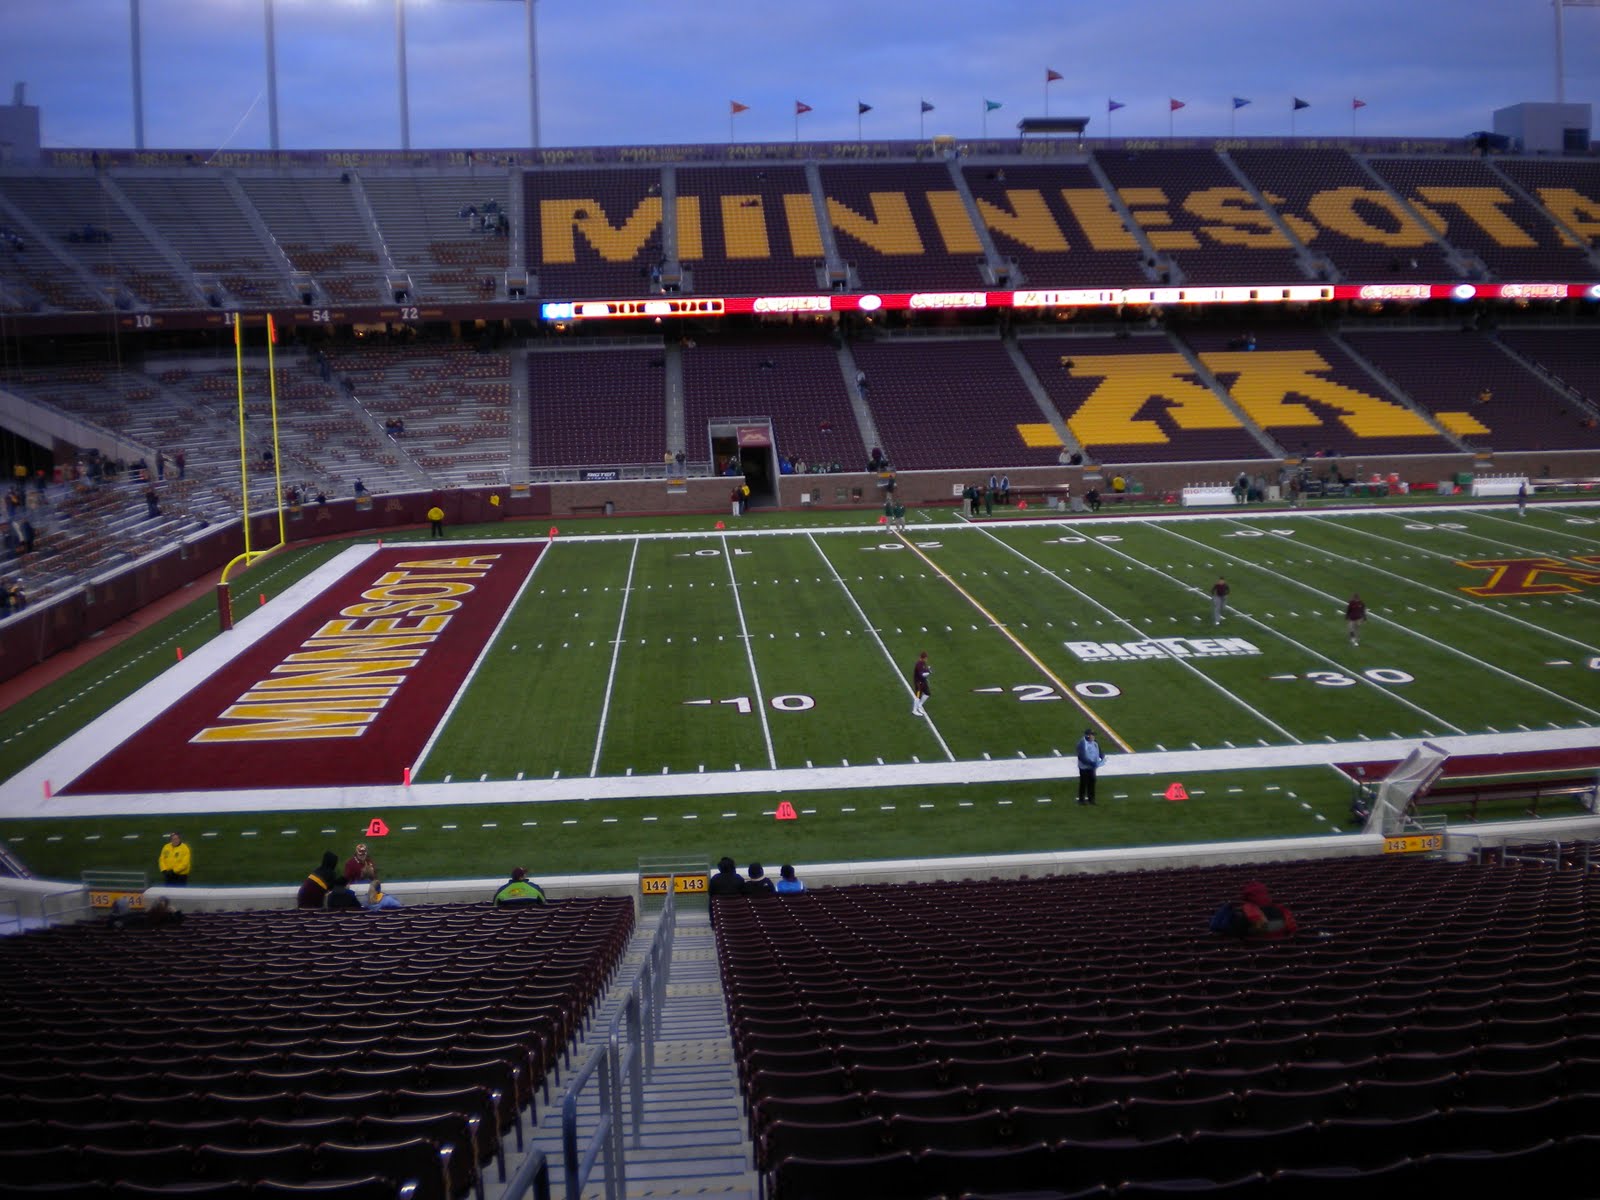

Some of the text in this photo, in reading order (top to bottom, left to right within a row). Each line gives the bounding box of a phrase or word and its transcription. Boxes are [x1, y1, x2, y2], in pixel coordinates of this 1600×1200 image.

[540, 187, 1600, 265] MINNESOTA
[312, 310, 330, 323] 54
[401, 307, 419, 320] 72
[135, 315, 151, 328] 10
[187, 553, 502, 743] MINNESOTA
[1305, 668, 1415, 687] 30
[1011, 681, 1122, 701] 20
[720, 694, 816, 714] 10
[781, 804, 791, 817] 10
[371, 821, 381, 834] G
[1387, 840, 1407, 851] 143
[645, 880, 668, 891] 144
[682, 879, 705, 890] 143
